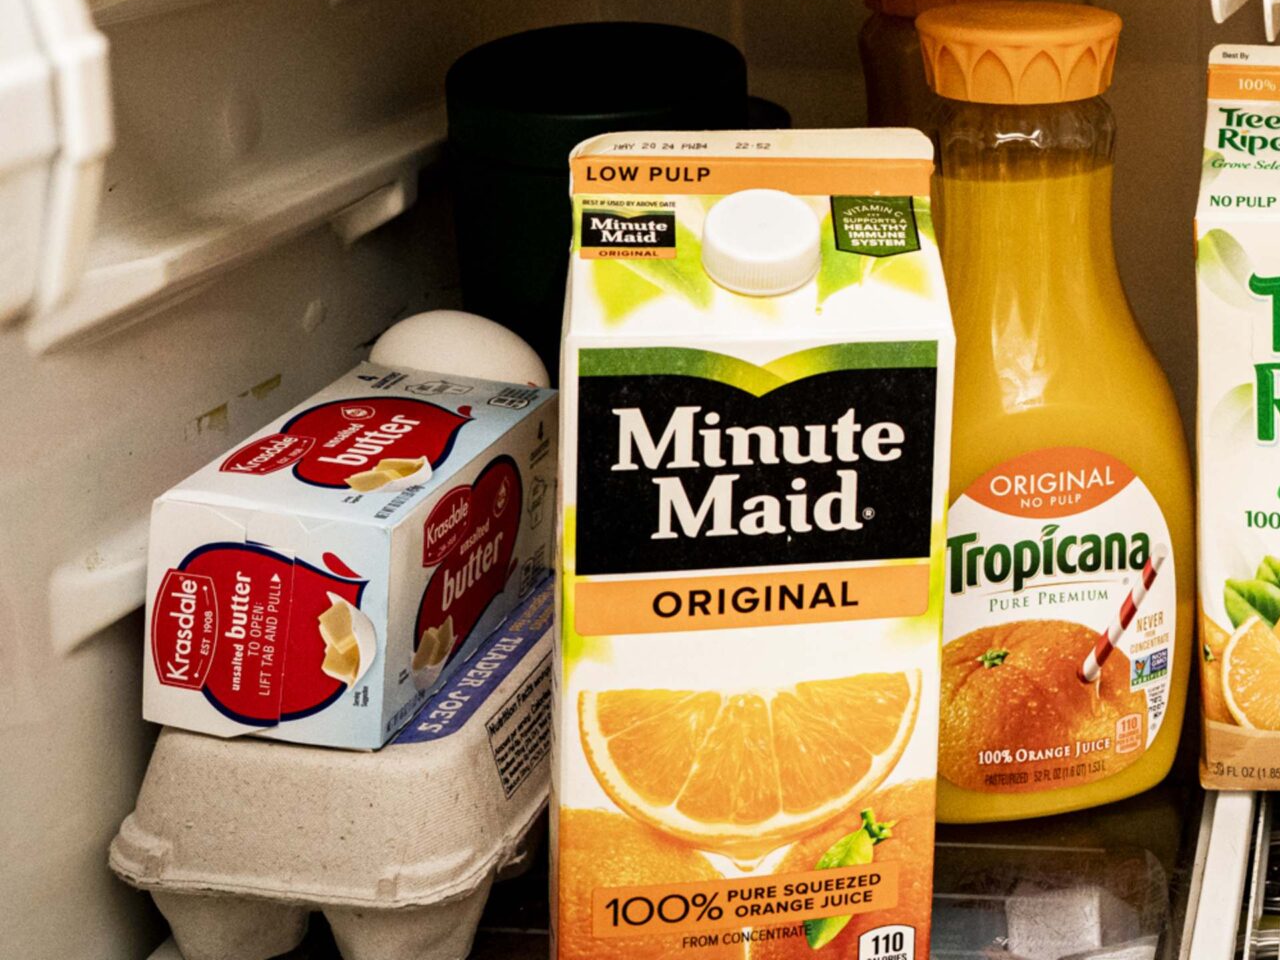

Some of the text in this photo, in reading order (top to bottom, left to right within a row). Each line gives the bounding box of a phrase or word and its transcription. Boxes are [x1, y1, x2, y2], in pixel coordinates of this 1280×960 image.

[1238, 78, 1276, 91] 100%
[586, 166, 711, 182] LOW PULP
[1209, 195, 1277, 208] NO PULP
[590, 217, 668, 232] Minute
[600, 230, 656, 243] Maid
[844, 224, 908, 232] HEALTHY
[849, 231, 905, 239] IMMUNE
[850, 239, 905, 247] SYSTEM
[318, 414, 421, 467] butter
[611, 406, 905, 471] Minute
[990, 466, 1115, 496] ORIGINAL
[651, 469, 863, 539] Maid
[1020, 494, 1082, 509] NO PULP
[426, 496, 469, 543] Krasdale
[441, 532, 504, 612] butter
[652, 581, 859, 618] ORIGINAL
[166, 578, 199, 681] Krasdale
[225, 571, 252, 691] unsalted butter
[458, 636, 524, 688] TRADER
[978, 750, 1012, 765] 100%
[728, 873, 881, 903] PURE SQUEEZED
[606, 892, 723, 927] 100%
[735, 891, 873, 918] ORANGE JUICE
[871, 932, 904, 954] 110
